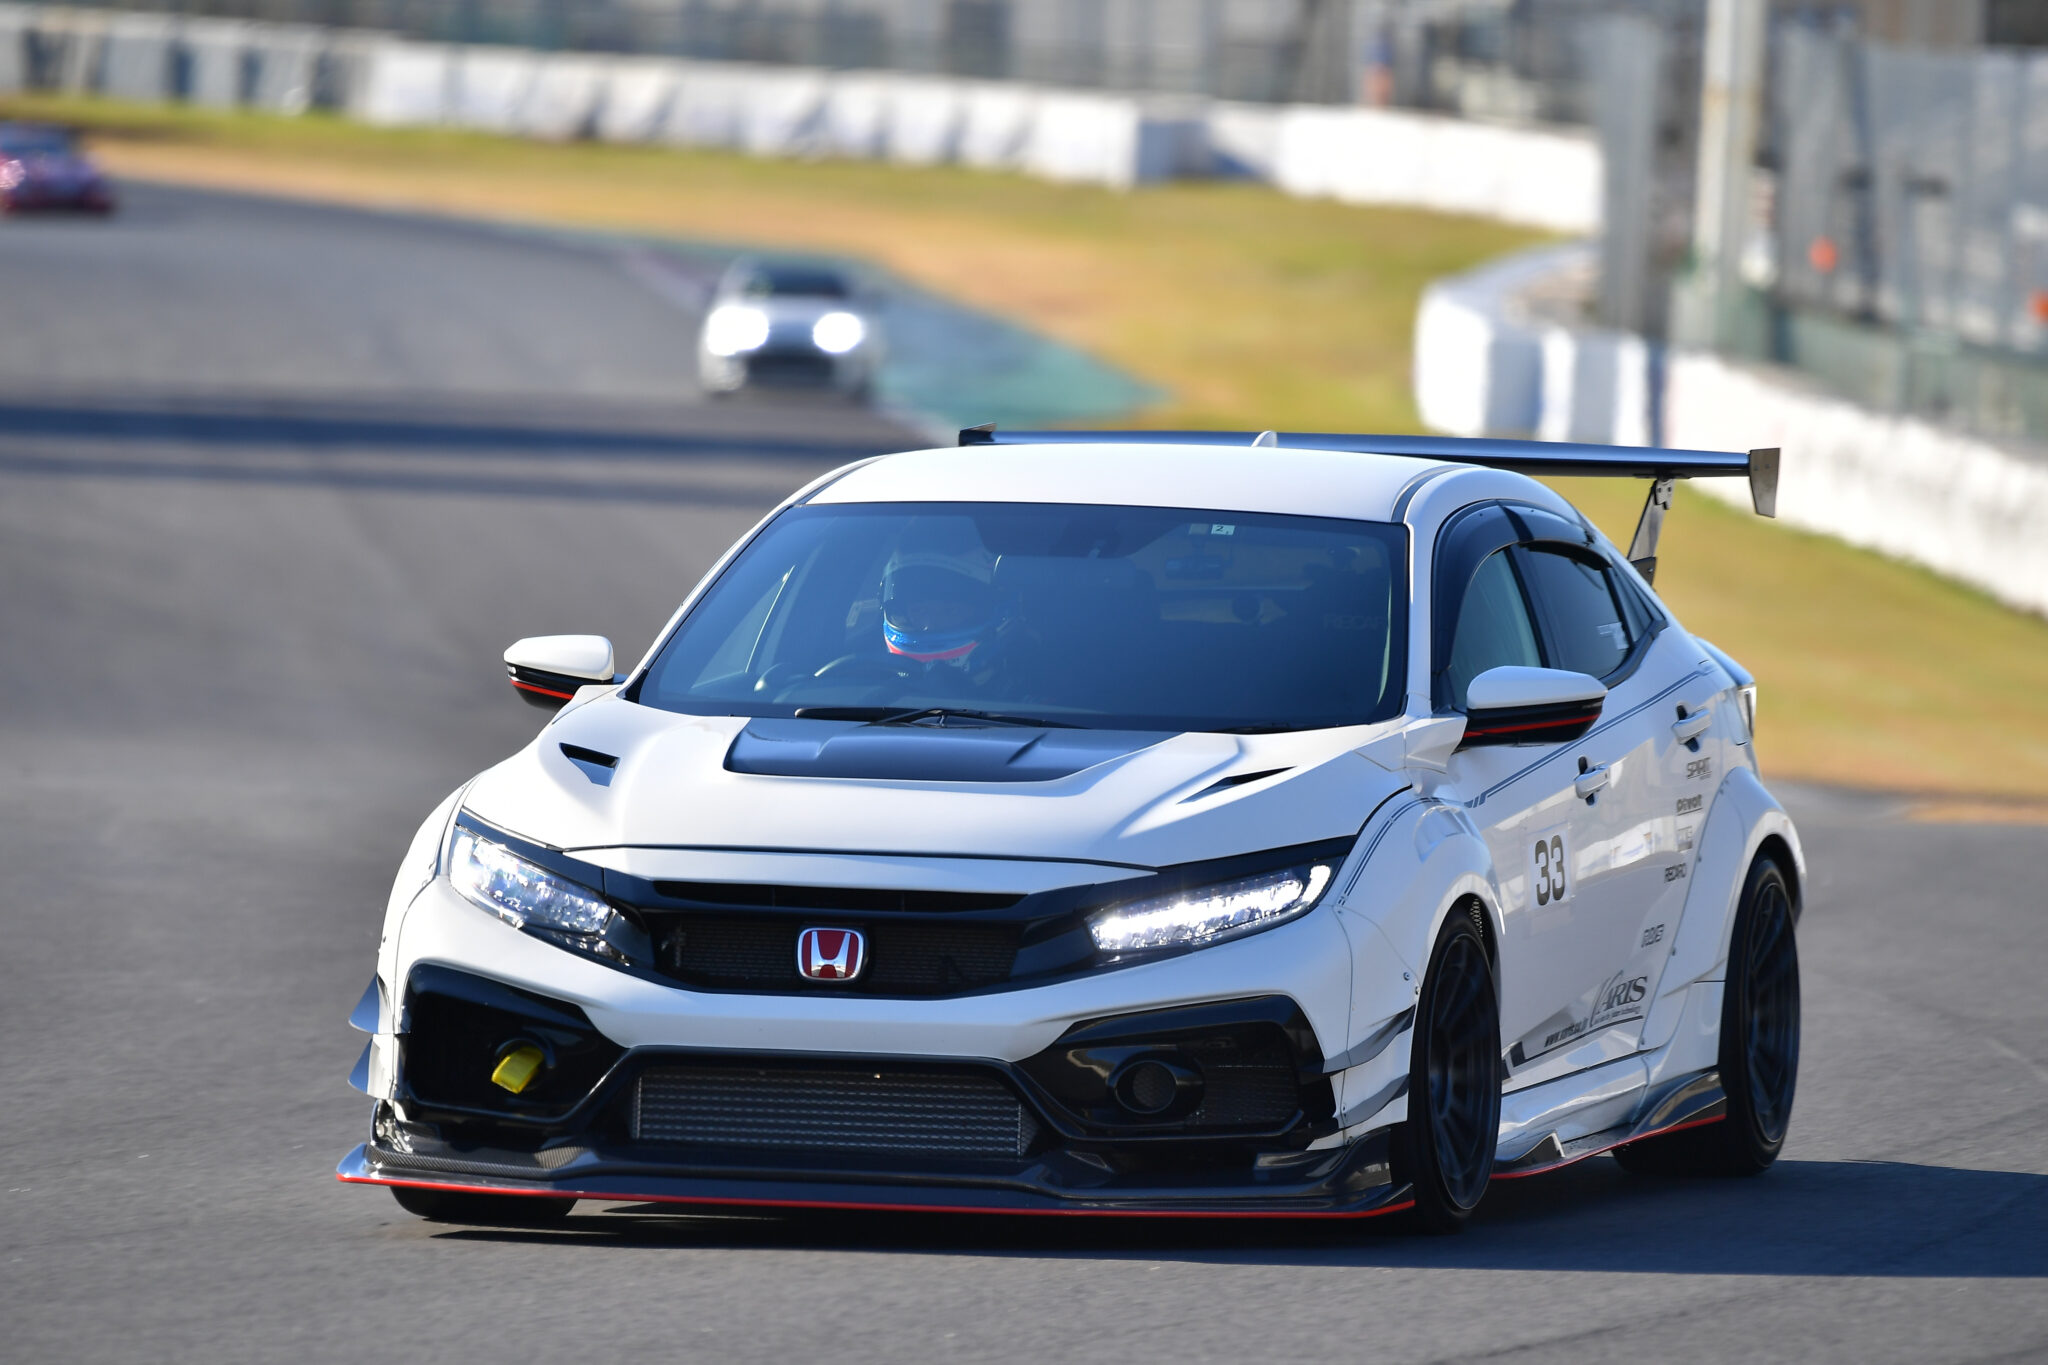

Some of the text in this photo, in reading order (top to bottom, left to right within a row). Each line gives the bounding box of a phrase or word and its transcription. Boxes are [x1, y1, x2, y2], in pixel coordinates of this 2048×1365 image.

[1322, 612, 1387, 631] RECAR
[1535, 834, 1565, 906] 33
[1589, 970, 1647, 1027] VARIS
